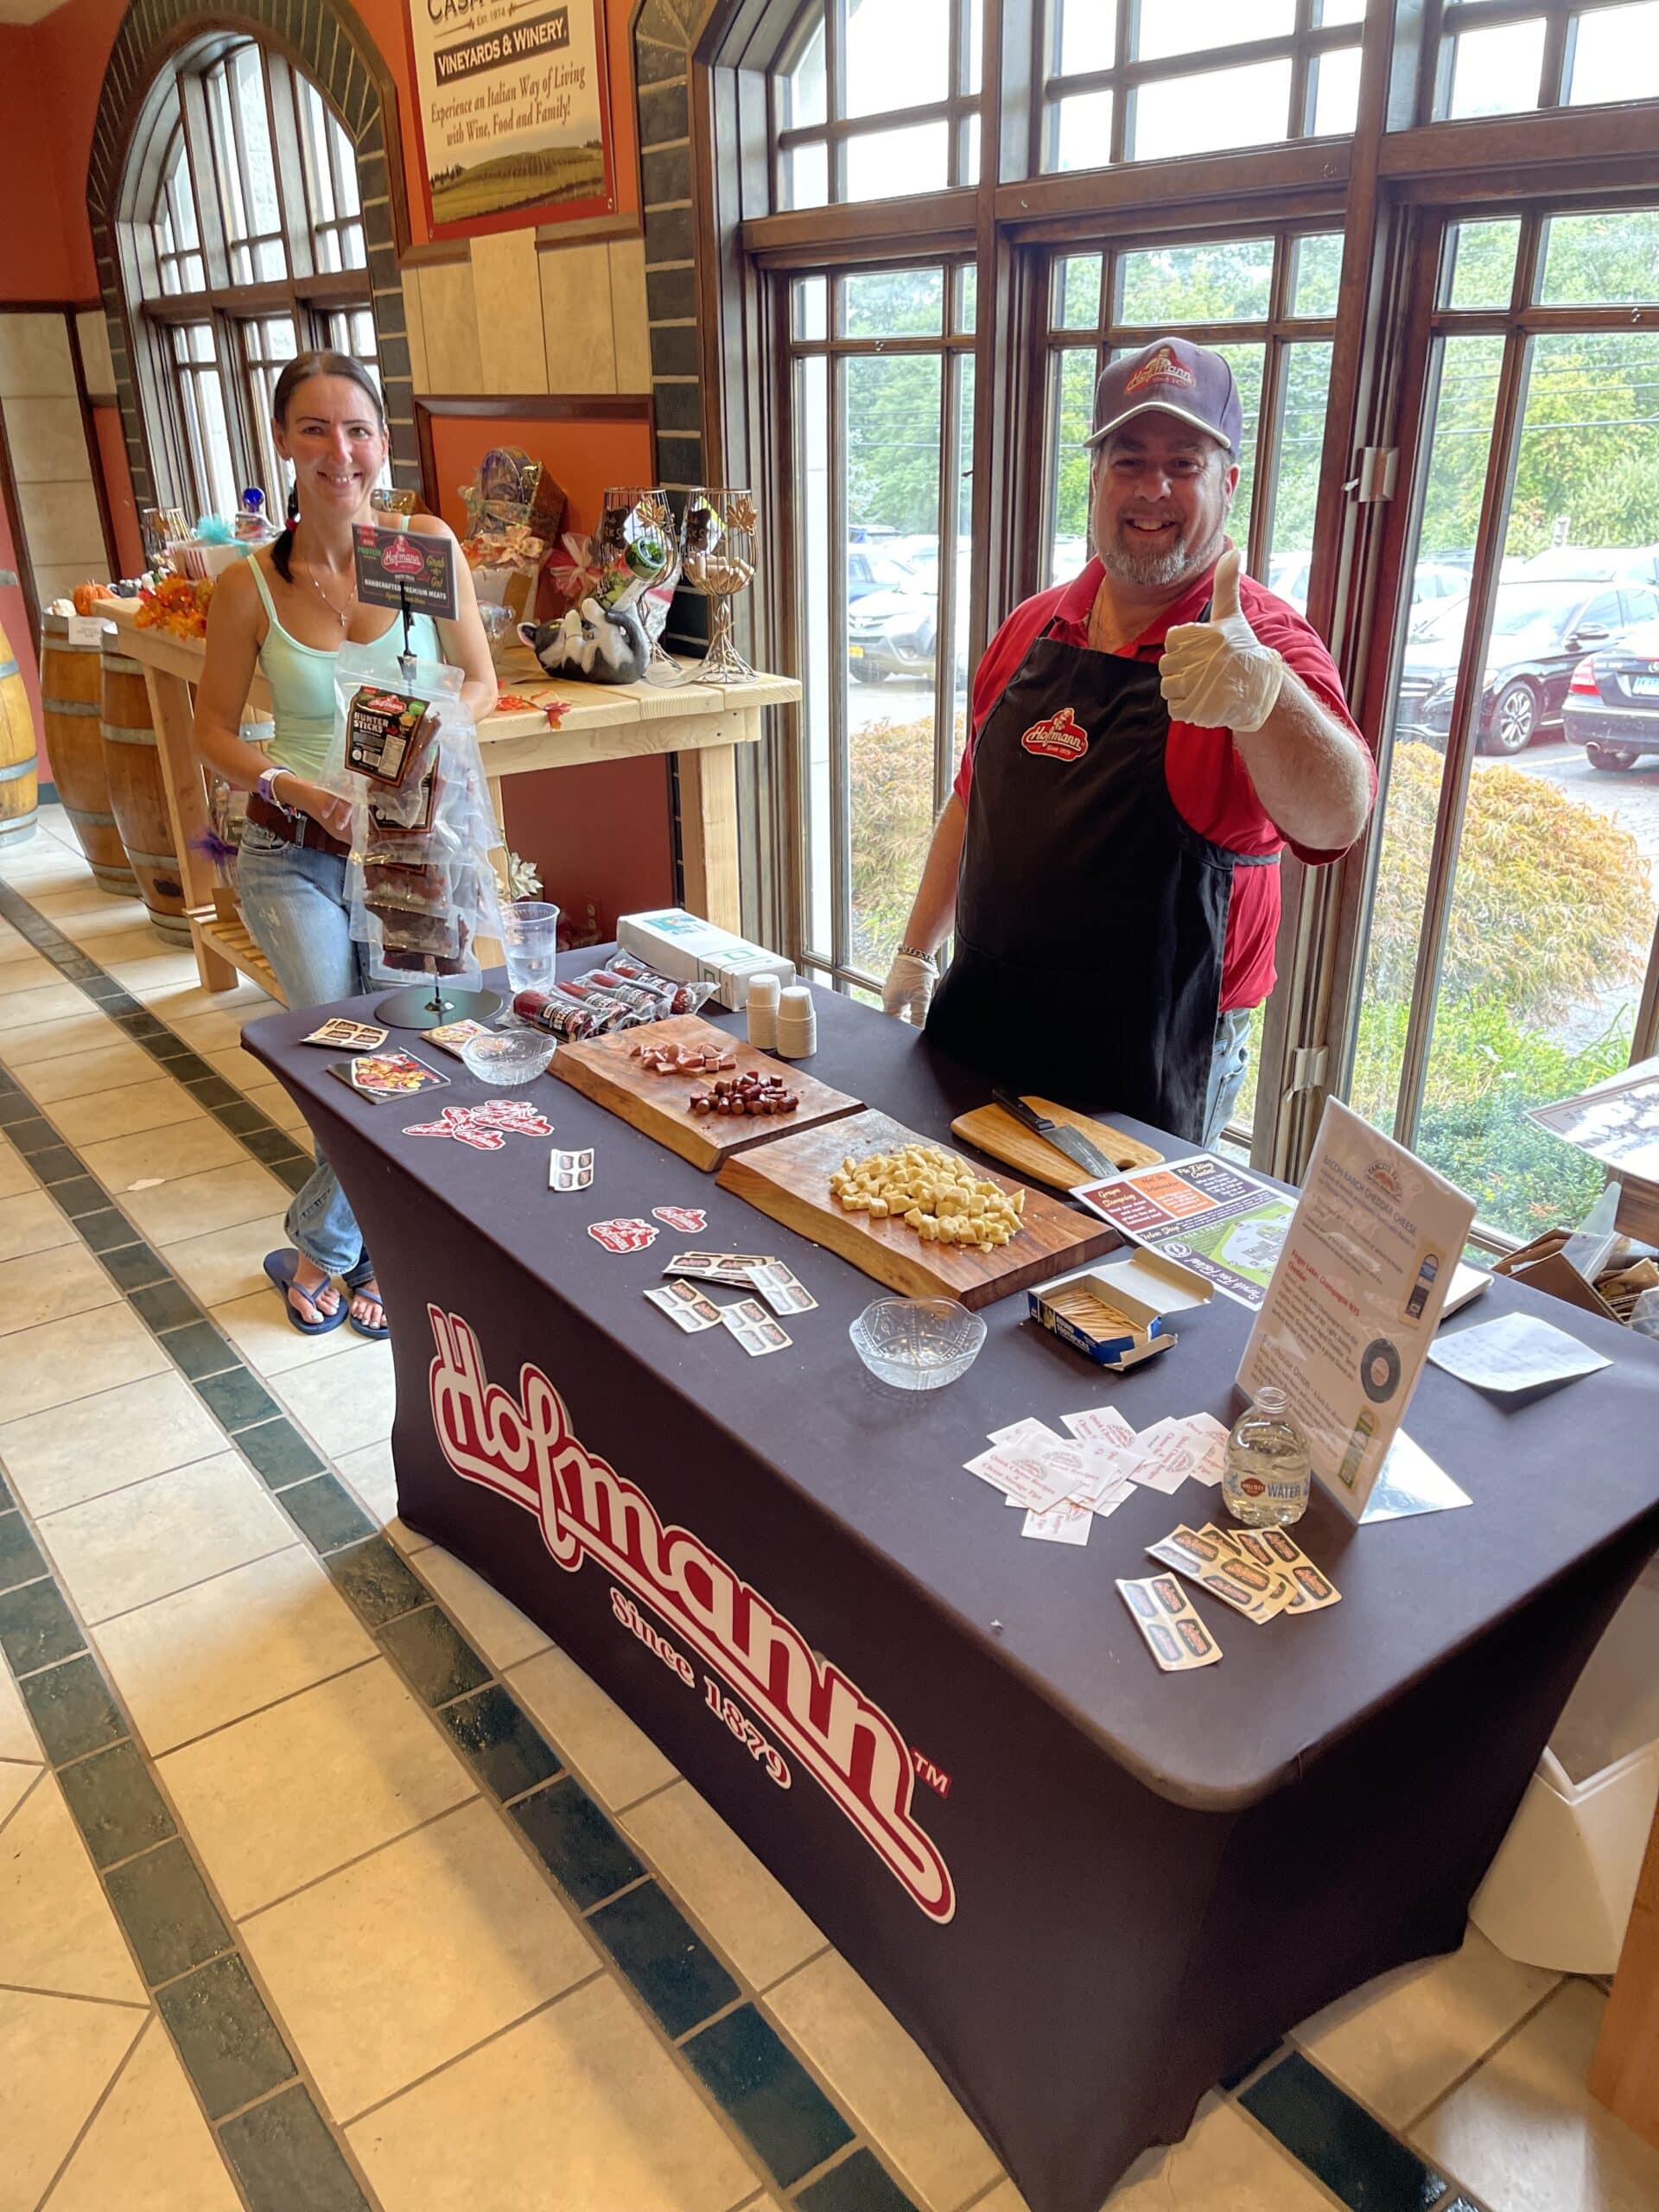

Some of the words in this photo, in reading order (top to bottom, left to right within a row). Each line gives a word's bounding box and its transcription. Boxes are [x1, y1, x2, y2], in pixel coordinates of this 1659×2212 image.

[438, 40, 500, 77] VINEYARDS
[502, 34, 512, 56] &
[513, 17, 564, 54] WINERY
[429, 97, 473, 127] Experience
[475, 94, 485, 109] an
[487, 82, 517, 108] Italian
[519, 74, 540, 104] Way
[543, 67, 554, 97] of
[554, 61, 586, 91] Living
[447, 122, 464, 146] with
[467, 118, 491, 143] Wine,
[493, 110, 515, 136] Food
[516, 105, 533, 126] and
[536, 96, 571, 126] Family!
[385, 551, 422, 566] Hofmann
[365, 579, 401, 592] HANDCRAFTED
[353, 720, 383, 733] STICKS
[354, 712, 389, 728] HUNTER
[1026, 726, 1082, 751] Hofmann
[1344, 1172, 1364, 1192] RANCH
[1394, 1211, 1417, 1236] CHEESE
[1292, 1249, 1306, 1266] Finger
[1349, 1302, 1360, 1316] NYS
[1268, 1484, 1300, 1498] WATER
[429, 1304, 956, 1924] Hofmann
[610, 1586, 695, 1688] Since
[704, 1675, 792, 1789] 1879
[912, 1753, 950, 1795] TM
